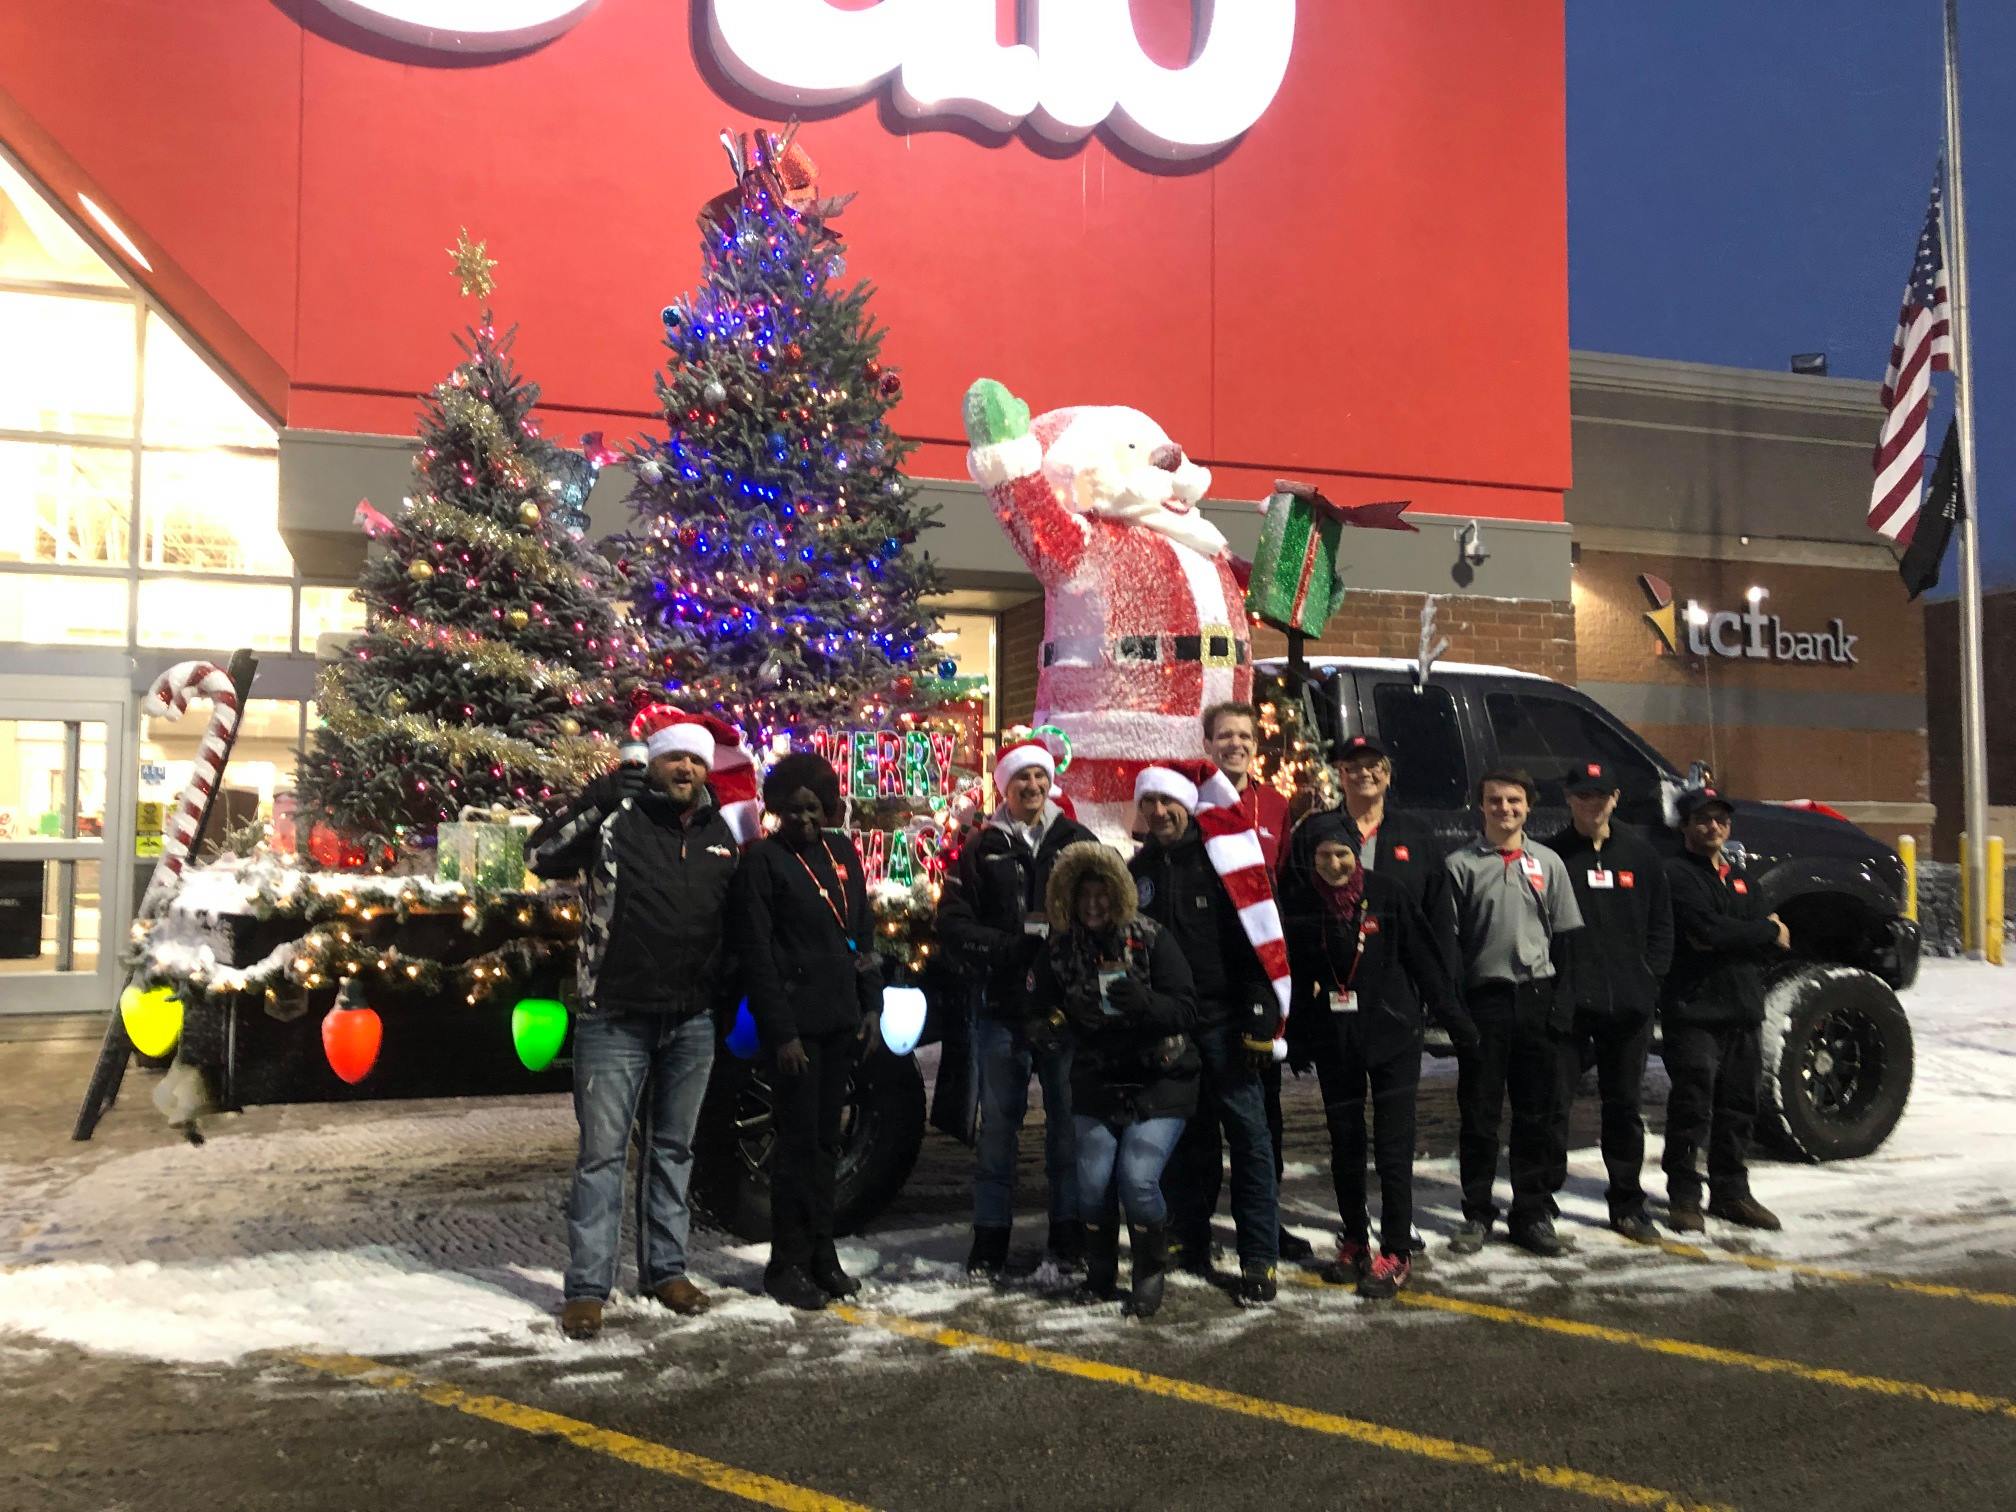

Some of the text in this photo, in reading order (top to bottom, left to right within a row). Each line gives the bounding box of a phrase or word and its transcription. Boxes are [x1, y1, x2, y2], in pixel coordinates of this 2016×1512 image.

[1681, 586, 1859, 663] tcf bank
[814, 727, 956, 800] MERRY
